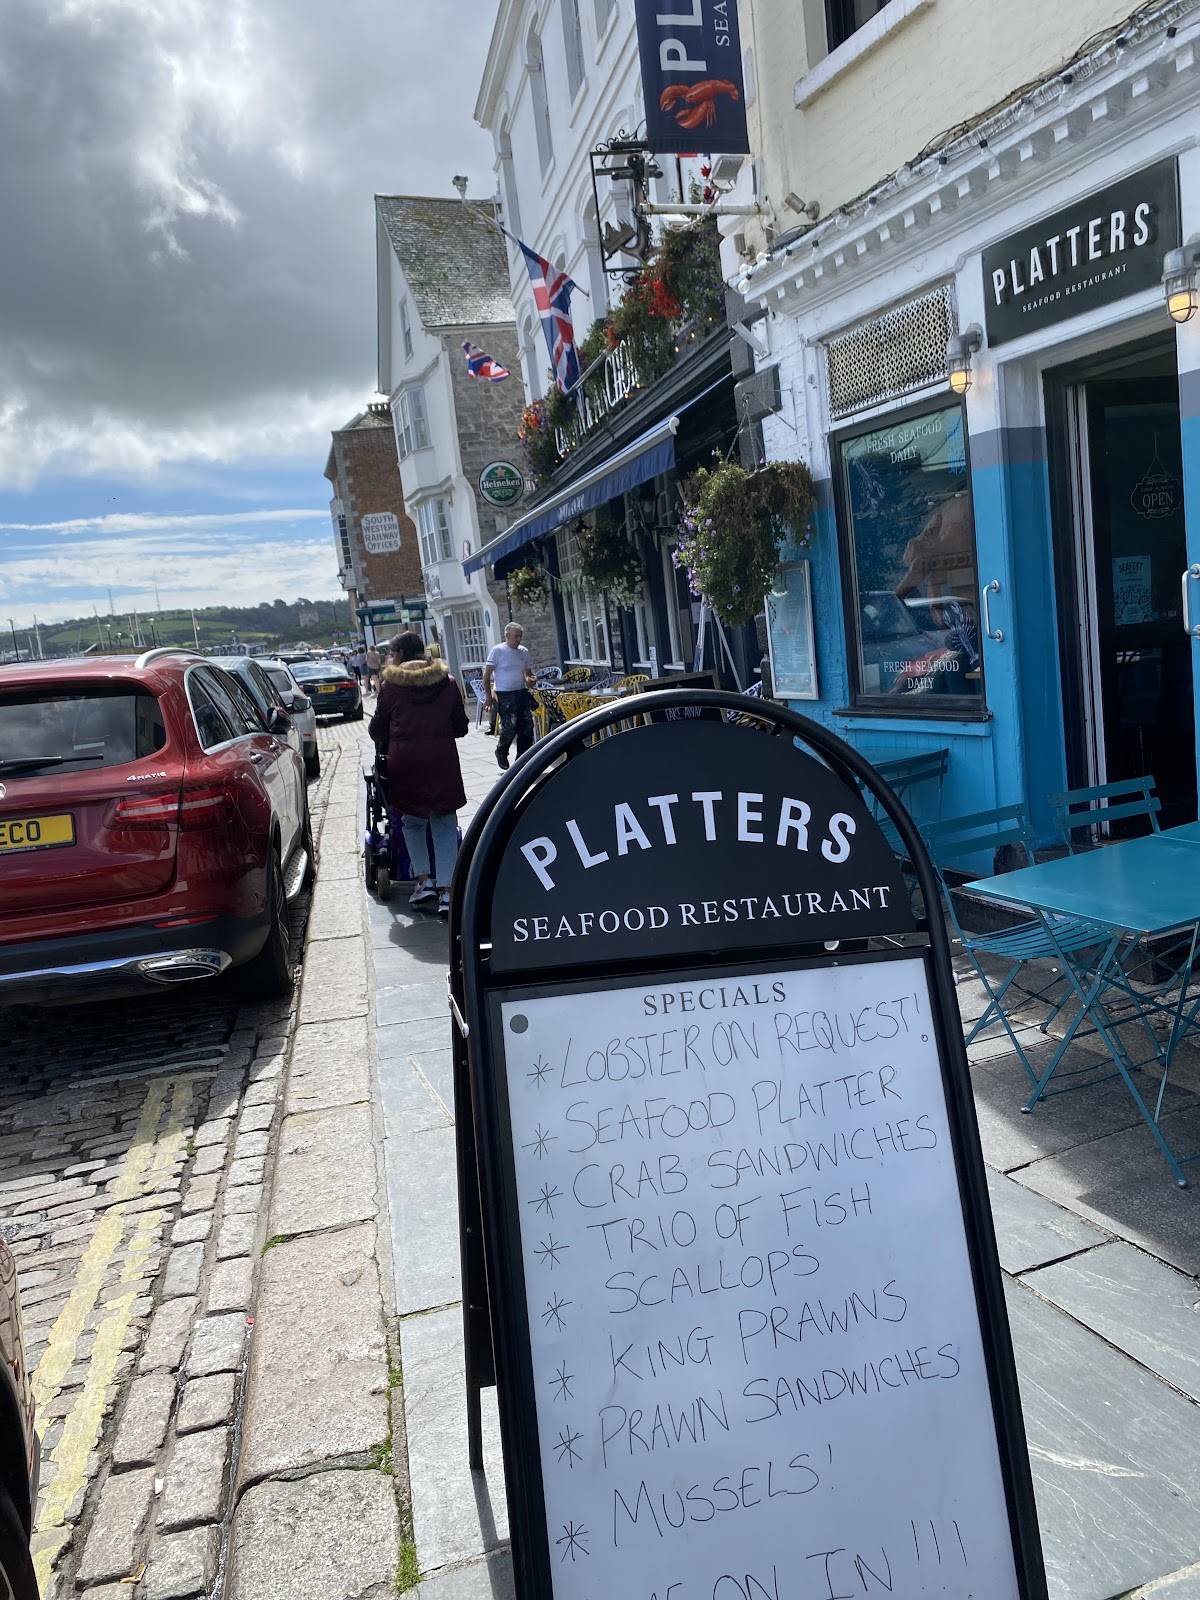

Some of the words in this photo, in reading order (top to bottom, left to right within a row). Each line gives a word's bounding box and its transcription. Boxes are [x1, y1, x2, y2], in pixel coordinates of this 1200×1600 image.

[992, 202, 1150, 306] PLATTERS
[1022, 291, 1061, 313] SEAFOOD
[1065, 263, 1128, 296] RESTAURANT
[867, 433, 895, 453] FRESH
[898, 420, 942, 443] SEAFOOD
[890, 446, 918, 464] DAILY
[482, 478, 521, 490] Heineken
[1142, 491, 1173, 508] OPEN
[363, 523, 397, 533] WESTERN
[364, 513, 394, 524] SOUTH
[365, 531, 399, 542] RAILWAY
[367, 540, 400, 550] OFFICES
[883, 661, 913, 673] FRESH
[915, 660, 960, 673] SEAFOOD
[907, 677, 935, 689] DAILY
[127, 771, 167, 782] 4MATIC
[519, 791, 857, 892] PLATTERS
[513, 905, 670, 943] SEAFOOD
[678, 886, 892, 927] RESTAURANT
[643, 981, 788, 1017] SPECIALS
[560, 1023, 706, 1089] LOBSTER
[711, 1021, 760, 1068] ON
[565, 1092, 736, 1154] SEAFOOD
[751, 1064, 903, 1137] PLATTER
[572, 1154, 688, 1209] CRAB
[707, 1114, 938, 1189] SANDWICHES
[586, 1210, 697, 1261] TRIO
[714, 1195, 763, 1246] OF
[780, 1182, 873, 1237] FISH
[604, 1244, 820, 1314] SCALLOPS
[609, 1326, 715, 1385] KING
[738, 1279, 907, 1365] PRAWNS
[598, 1390, 730, 1469] PRAWN
[742, 1343, 961, 1424] SANDWICHES
